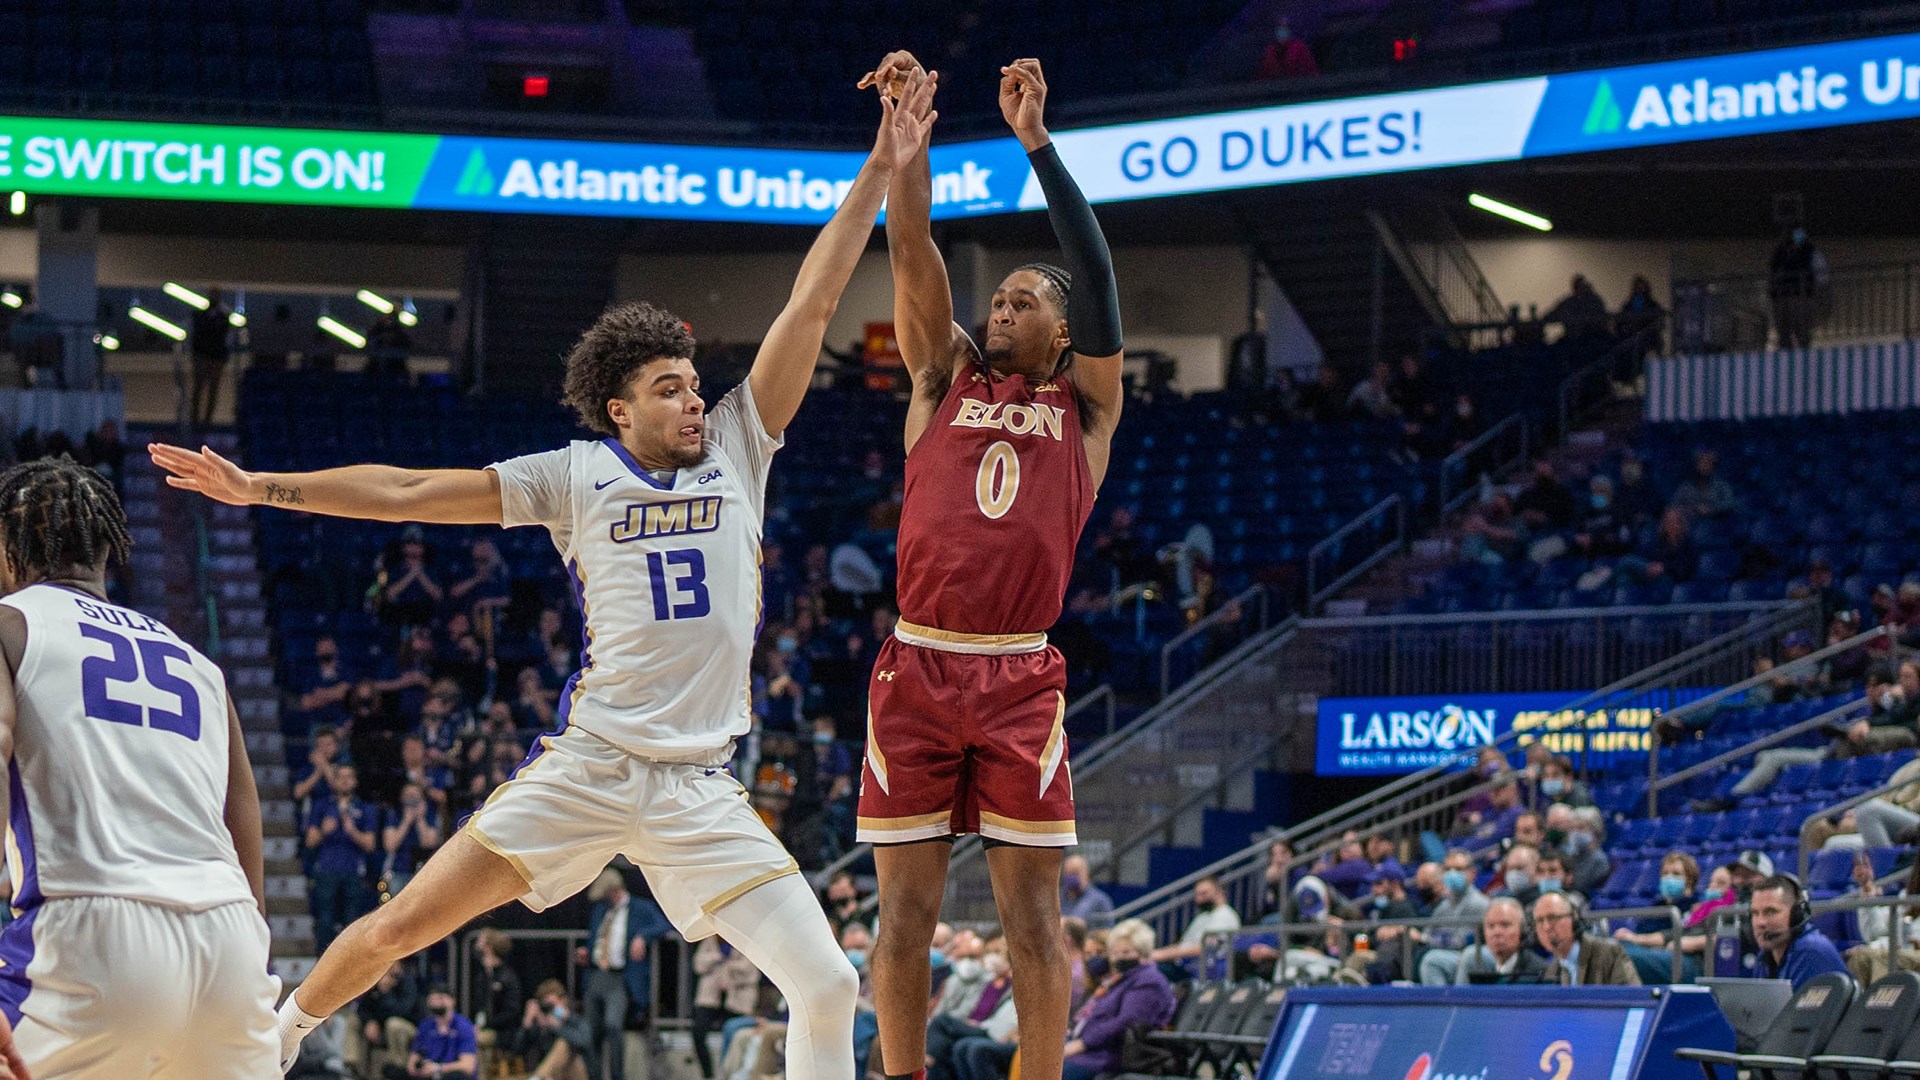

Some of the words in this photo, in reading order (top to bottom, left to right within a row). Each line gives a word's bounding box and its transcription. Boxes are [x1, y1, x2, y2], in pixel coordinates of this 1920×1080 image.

[1627, 65, 1848, 130] Atlantic
[24, 136, 225, 185] SWITCH
[239, 146, 283, 187] IS
[291, 147, 385, 192] ON!
[1121, 136, 1198, 182] GO
[1221, 110, 1421, 172] DUKES!
[499, 159, 706, 205] Atlantic
[950, 397, 1066, 441] ELON
[698, 469, 723, 485] CAA
[976, 440, 1020, 519] 0
[610, 495, 723, 543] JMU
[646, 548, 711, 621] 13
[75, 599, 167, 636] SULE
[78, 622, 201, 742] 25
[1340, 704, 1496, 749] LARSON
